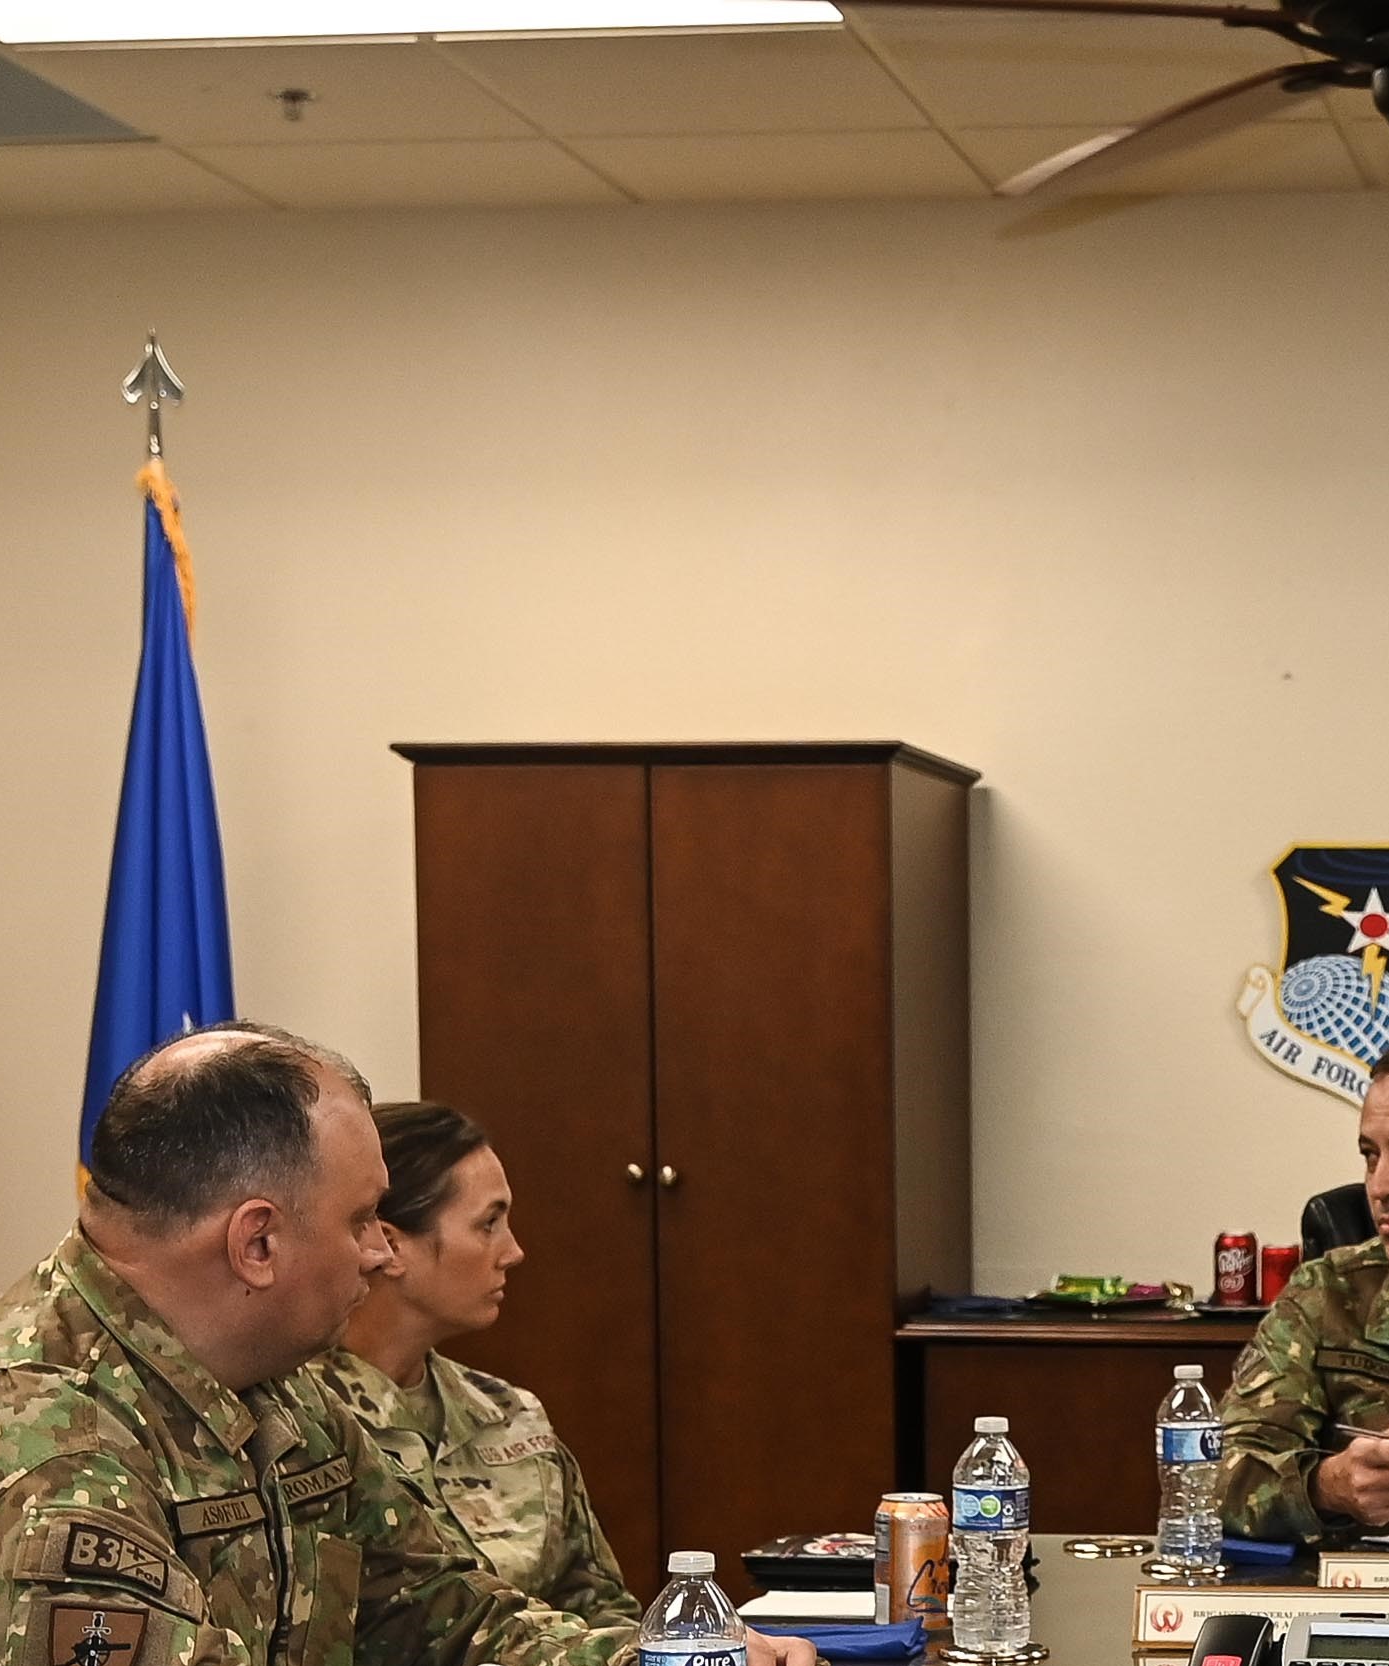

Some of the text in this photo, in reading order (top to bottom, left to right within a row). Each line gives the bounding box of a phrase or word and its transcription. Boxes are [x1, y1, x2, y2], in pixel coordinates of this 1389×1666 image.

[1259, 1029, 1369, 1099] AIR FORC
[70, 1531, 120, 1568] B3
